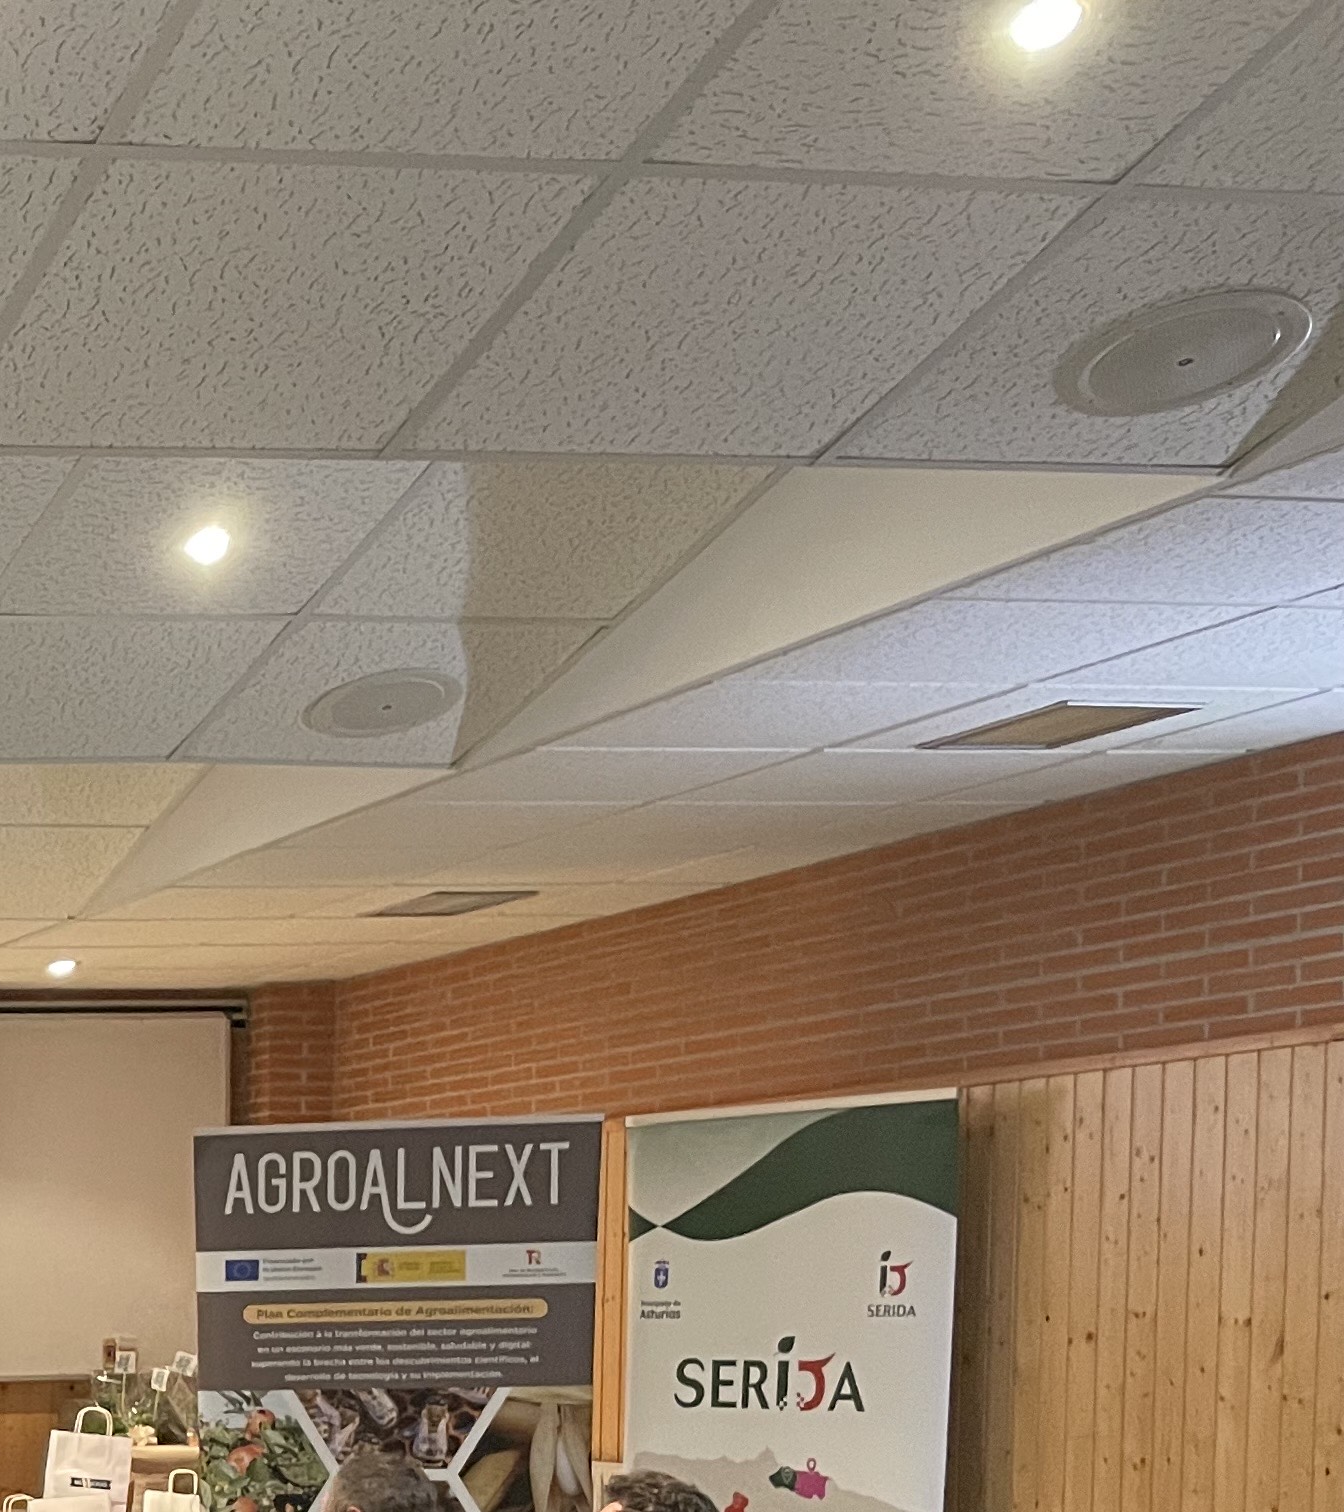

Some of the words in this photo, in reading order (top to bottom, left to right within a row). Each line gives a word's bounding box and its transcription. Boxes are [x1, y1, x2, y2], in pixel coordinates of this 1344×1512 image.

[223, 1141, 571, 1235] AGROALNEXT
[256, 1309, 283, 1320] Plan
[286, 1307, 393, 1320] Complementario
[395, 1306, 412, 1317] de
[639, 1309, 681, 1320] Asturias
[867, 1304, 916, 1318] SERIDA
